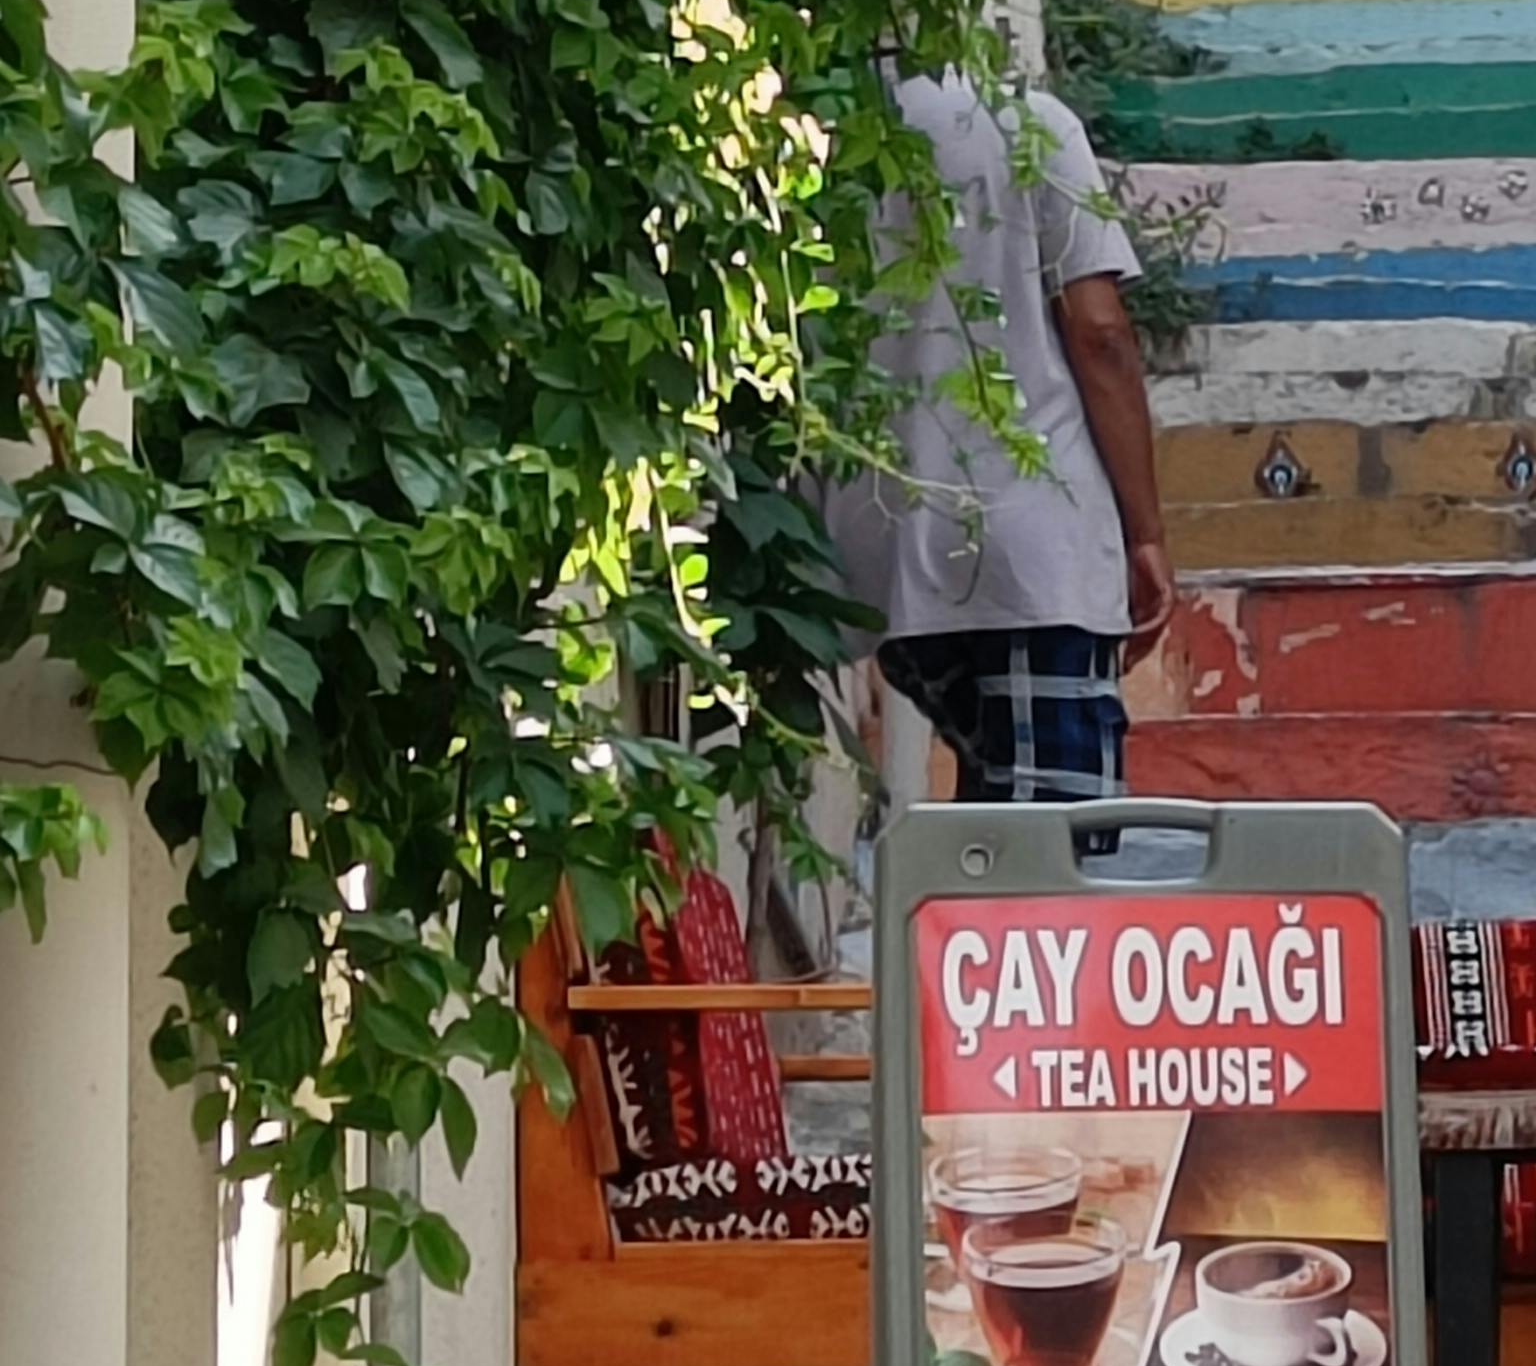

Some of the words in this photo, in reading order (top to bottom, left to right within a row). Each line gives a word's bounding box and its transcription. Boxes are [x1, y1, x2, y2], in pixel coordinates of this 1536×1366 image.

[942, 929, 1088, 1057] ÇAY
[1110, 902, 1343, 1027] OCAĞI
[1031, 1048, 1117, 1108] TEA
[1127, 1046, 1274, 1107] HOUSE
